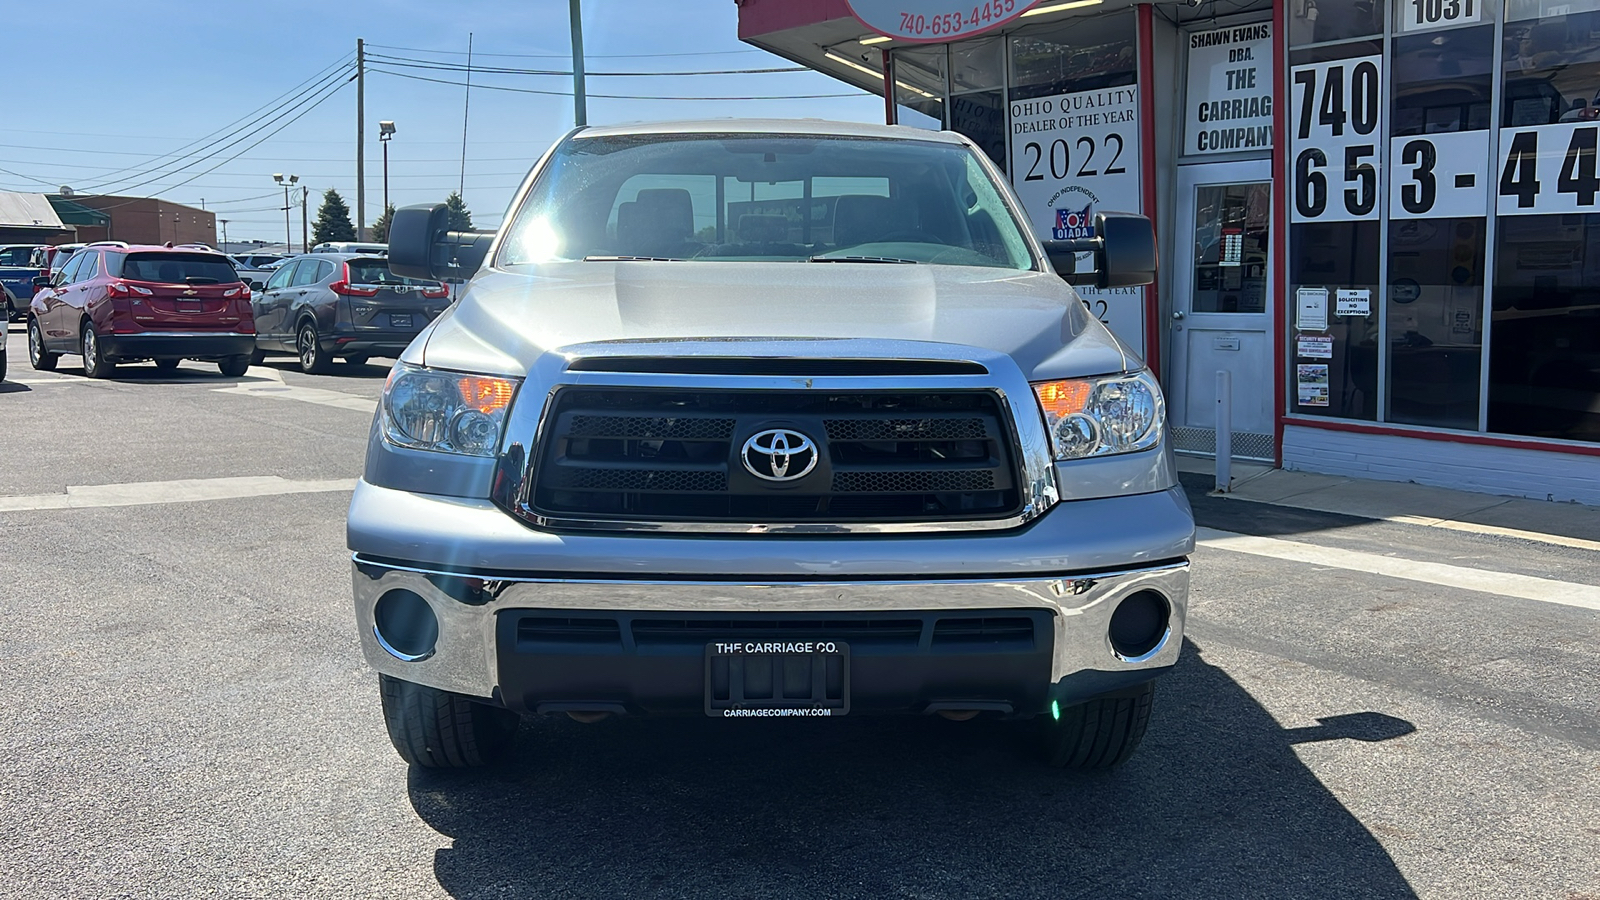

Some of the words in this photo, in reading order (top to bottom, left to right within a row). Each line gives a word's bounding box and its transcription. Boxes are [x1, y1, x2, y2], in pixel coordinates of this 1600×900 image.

[899, 0, 1015, 35] 740-653-4455
[1412, 0, 1473, 24] 1031
[1191, 29, 1230, 49] SHAWN
[1232, 24, 1271, 43] EVANS.
[1228, 47, 1254, 63] DBA.
[1225, 67, 1257, 91] THE
[1012, 100, 1053, 118] OHIO
[1060, 89, 1136, 114] QUALITY
[1198, 95, 1274, 123] CARRIAG
[1294, 61, 1378, 139] 740
[1014, 119, 1057, 134] DEALER
[1059, 116, 1074, 129] OF
[1076, 113, 1100, 127] THE
[1103, 109, 1134, 124] YEAR
[1024, 132, 1126, 182] 2022
[1047, 191, 1061, 207] OHIO
[1060, 185, 1100, 204] INDEPENDENT
[1057, 227, 1089, 239] OIADA
[1108, 286, 1136, 295] YEAR
[715, 642, 742, 654] THE
[745, 642, 813, 653] CARRIAGE
[816, 641, 838, 653] CO.
[723, 708, 831, 718] CARRIAGECOMPANY.COM
